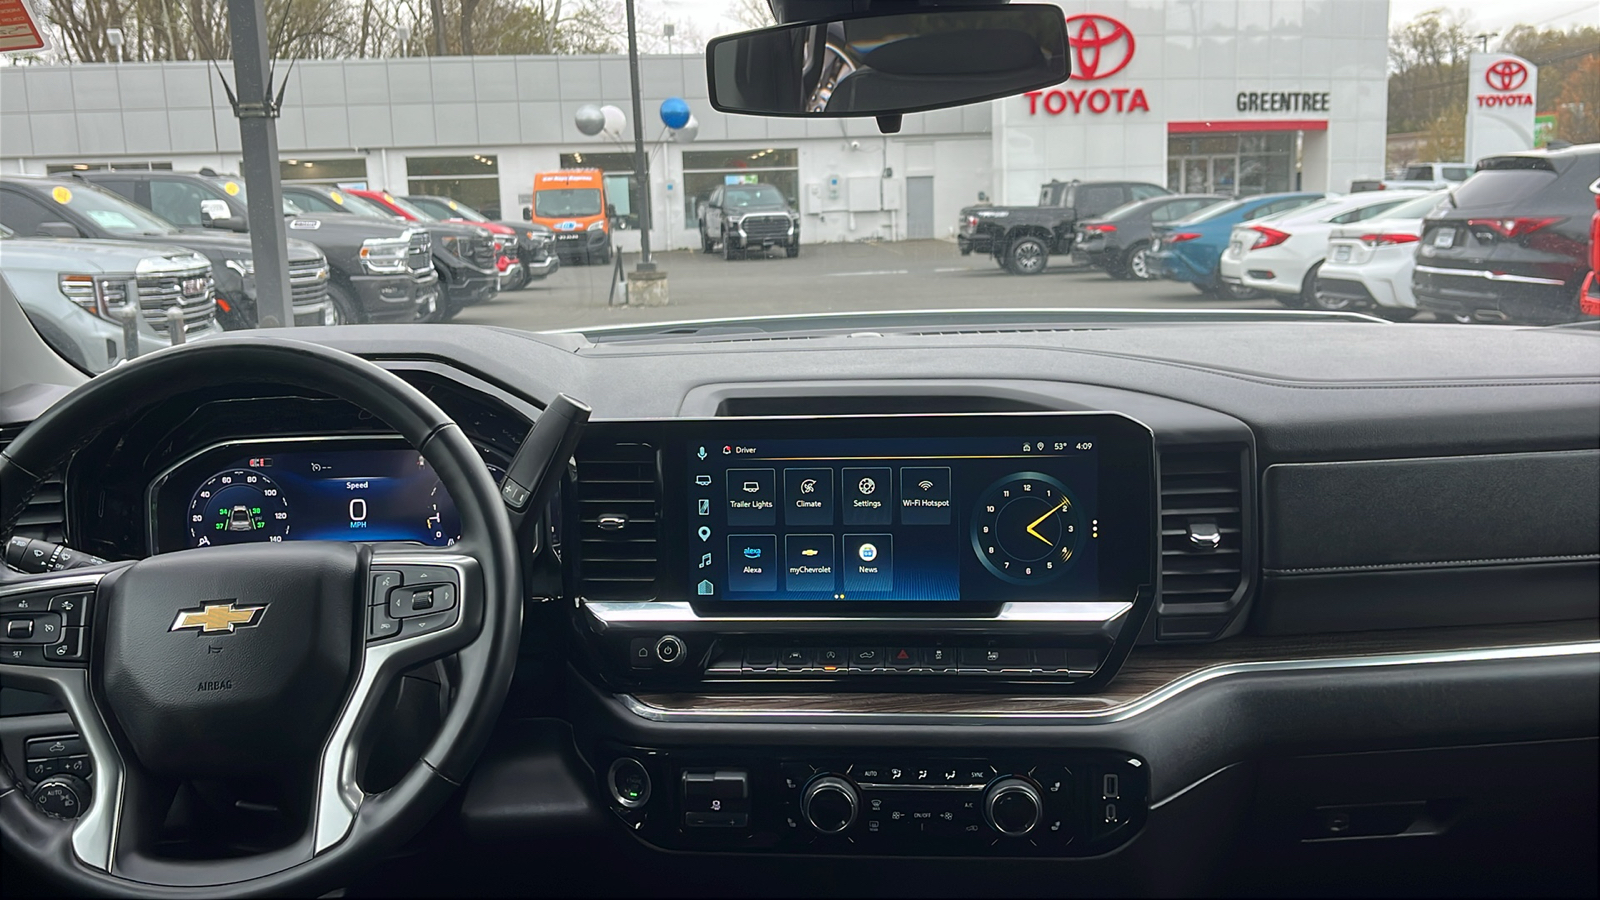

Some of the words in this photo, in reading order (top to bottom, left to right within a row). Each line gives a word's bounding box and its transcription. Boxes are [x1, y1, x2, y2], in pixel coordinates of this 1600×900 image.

[1025, 88, 1150, 115] TOYOTA
[1236, 92, 1330, 112] GREENTREE
[1476, 93, 1533, 107] TOYOTA
[735, 446, 757, 454] Driver
[1075, 442, 1093, 450] 4:09
[346, 481, 369, 490] Speed
[730, 500, 751, 508] Trailer
[752, 500, 773, 509] Lights
[796, 500, 822, 508] Climate
[853, 500, 882, 509] Settings
[902, 499, 921, 507] Wi-Fi
[921, 499, 950, 508] Hotspot
[349, 498, 367, 521] 0
[743, 566, 762, 574] Alexa
[789, 566, 831, 575] myChevrolet
[1026, 567, 1031, 575] 6
[197, 681, 232, 691] AIRBAG
